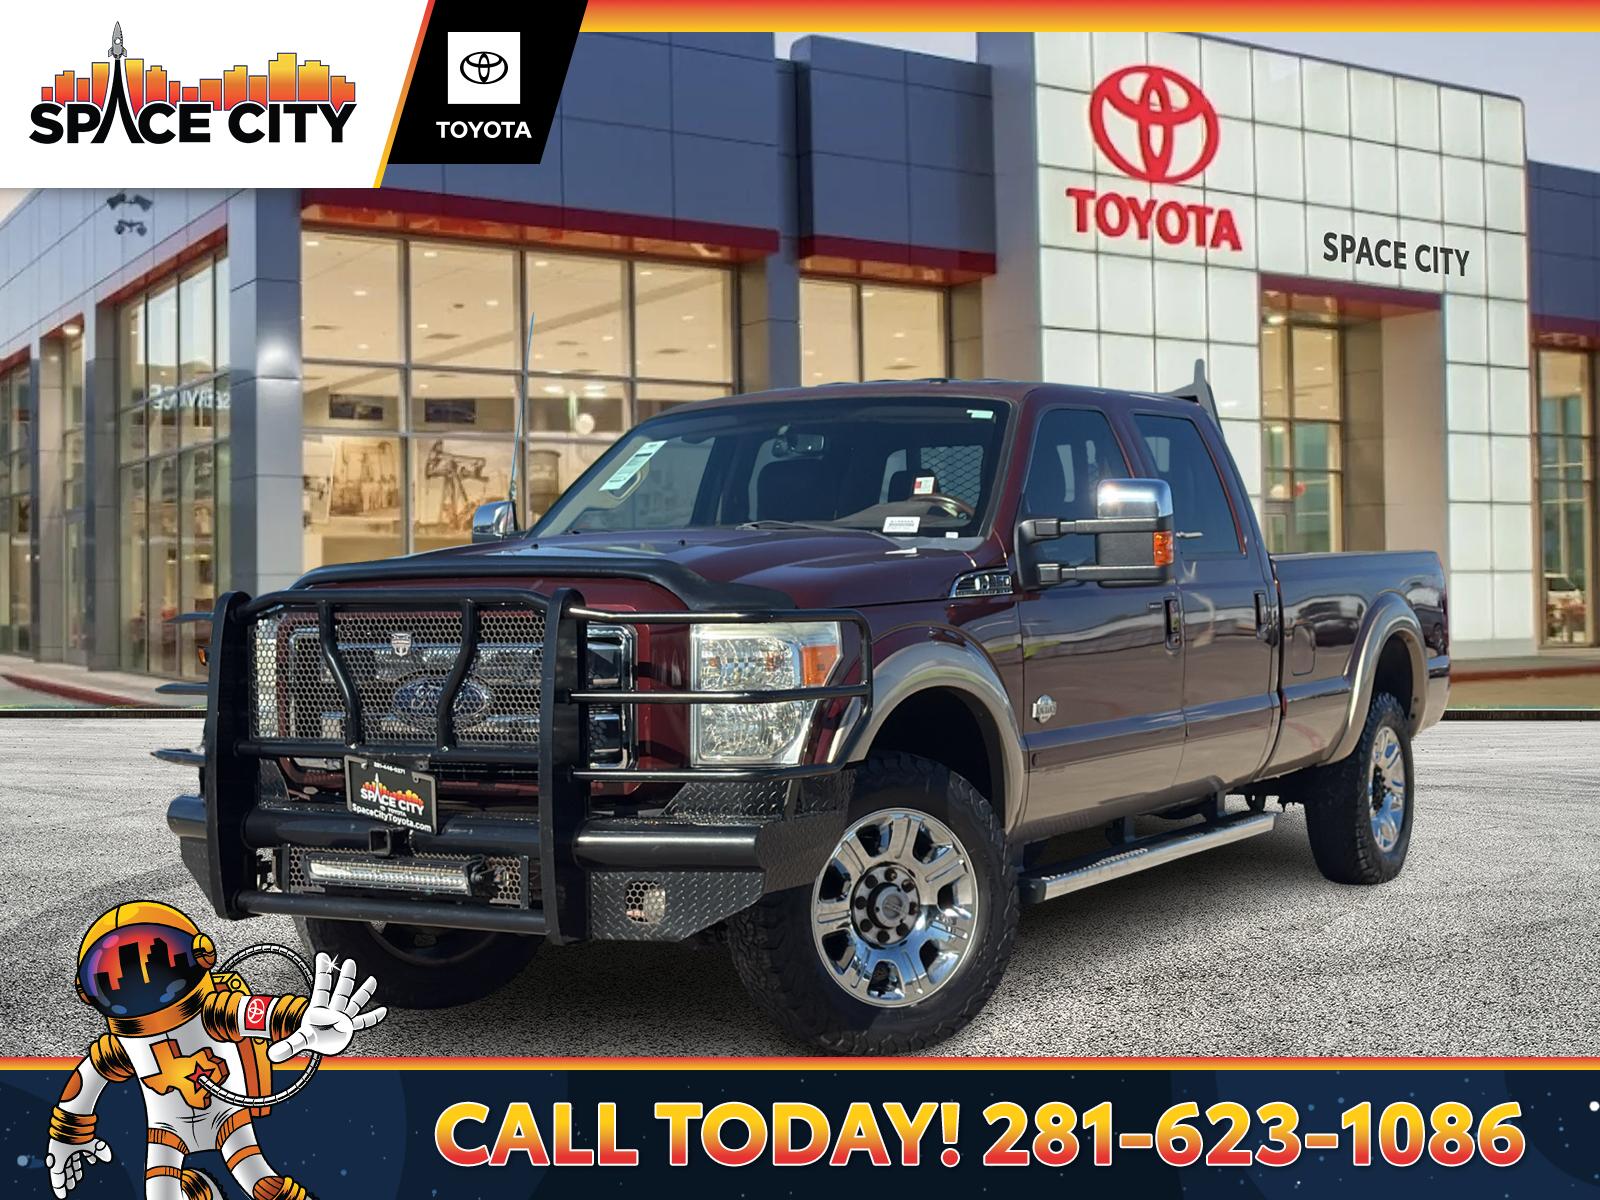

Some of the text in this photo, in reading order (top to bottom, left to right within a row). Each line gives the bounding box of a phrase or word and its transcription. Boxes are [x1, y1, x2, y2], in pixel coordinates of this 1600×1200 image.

[1066, 187, 1242, 251] TOYOTA
[1323, 232, 1470, 277] SPACE CITY
[352, 803, 432, 832] SpaceCityToyota.com
[360, 780, 424, 816] SPACE CITY
